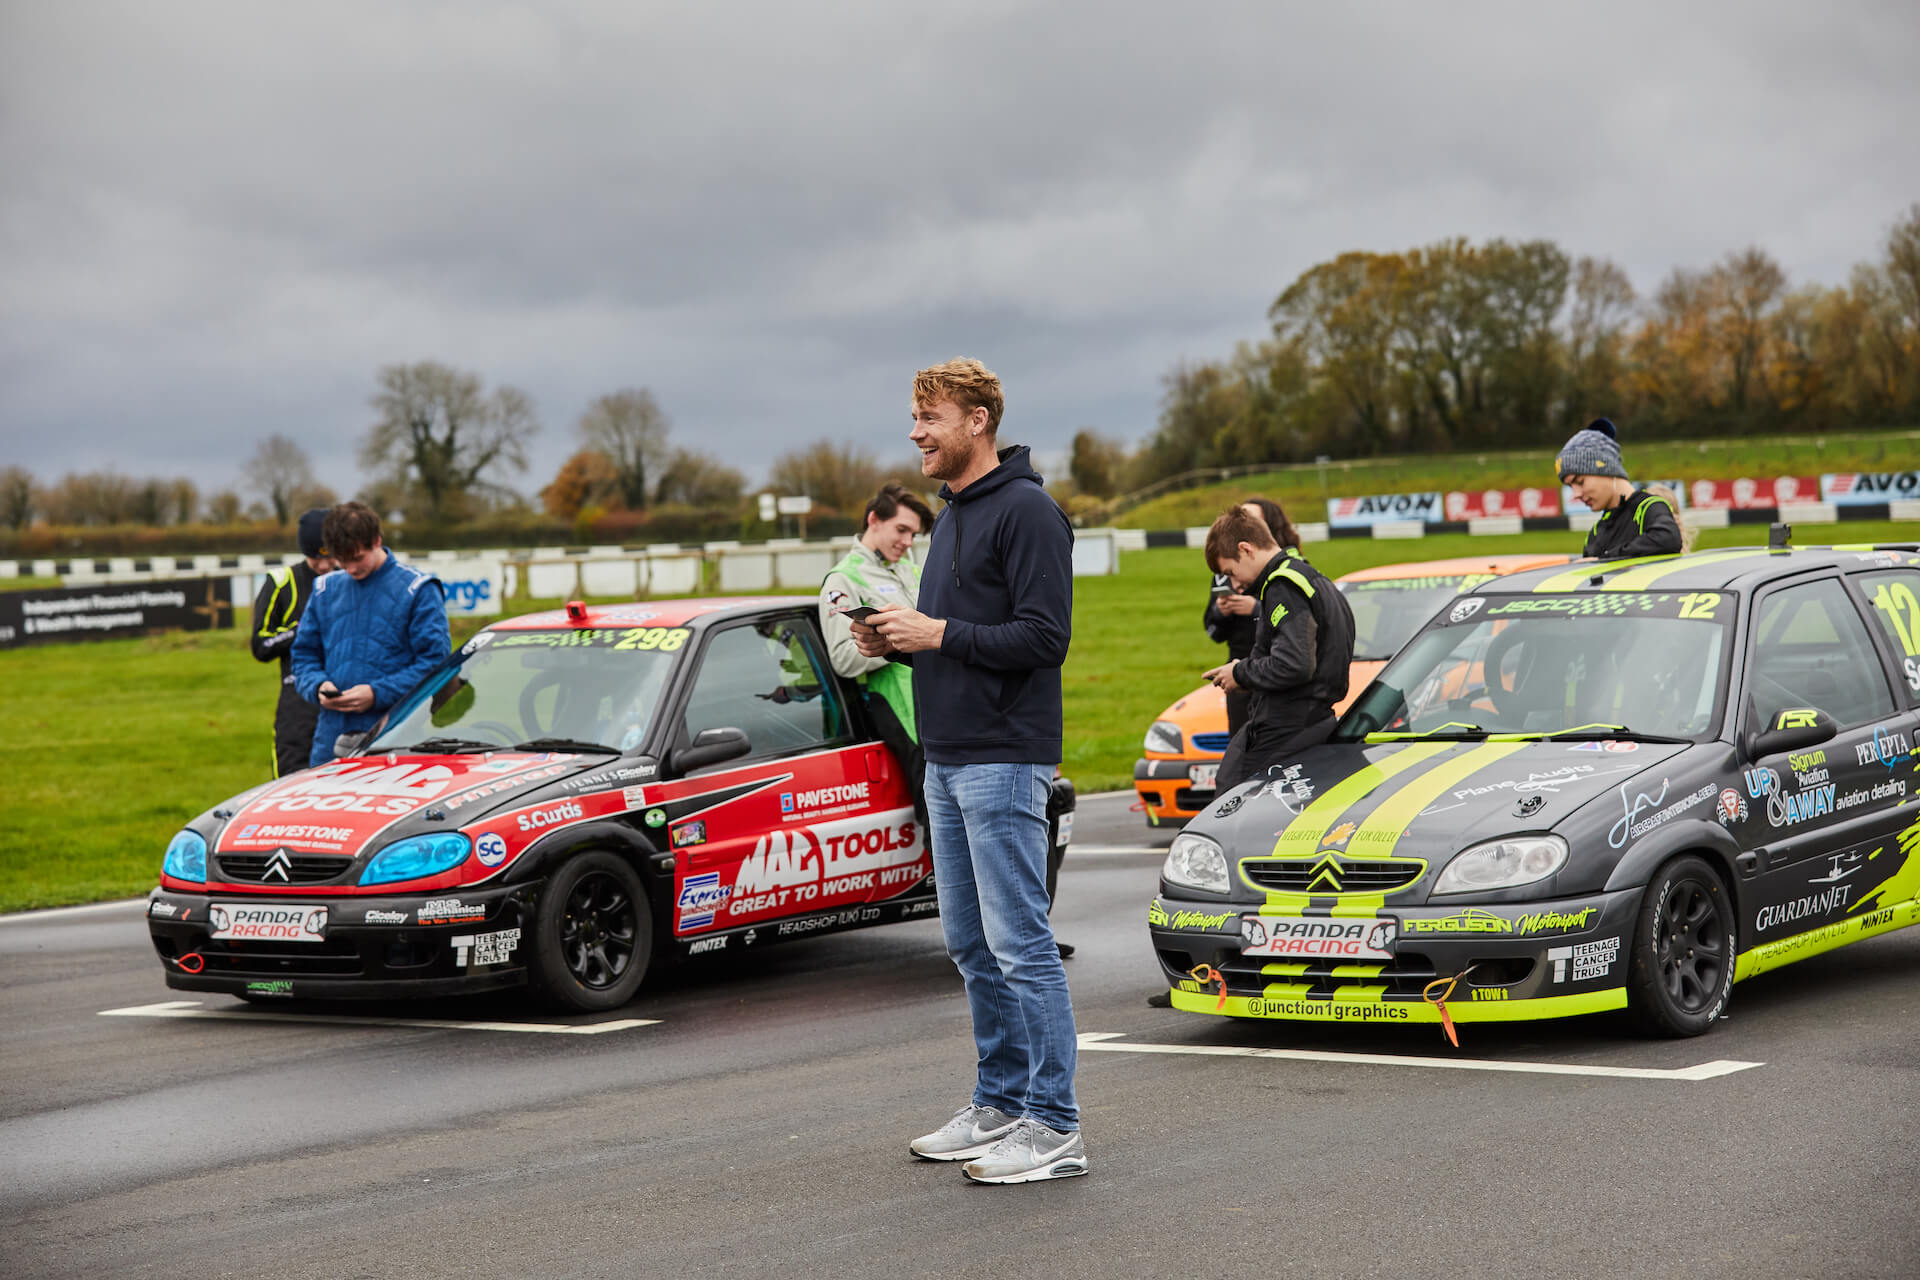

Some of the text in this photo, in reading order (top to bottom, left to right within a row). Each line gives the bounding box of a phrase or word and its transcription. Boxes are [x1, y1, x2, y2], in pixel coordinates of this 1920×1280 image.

[1358, 493, 1436, 515] AVON
[1487, 599, 1579, 614] JSCC
[1677, 592, 1721, 619] 12
[614, 627, 692, 651] 298
[1855, 725, 1910, 768] PERCEPTA
[1789, 750, 1826, 772] Signum
[1453, 763, 1596, 800] Plane Audits
[1744, 767, 1772, 799] UP
[1798, 768, 1829, 787] Aviation
[251, 794, 420, 816] TOOLS
[796, 782, 870, 808] PAVESTONE
[1767, 769, 1789, 828] &
[1787, 783, 1836, 826] AWAY
[1836, 789, 1870, 811] aviation
[1871, 779, 1906, 801] detailing
[517, 802, 583, 831] S.Curtis
[257, 825, 354, 841] PAVESTONE
[826, 823, 917, 862] TOOLS
[479, 841, 502, 857] SC
[729, 890, 792, 917] GREAT
[795, 884, 819, 903] TO
[822, 872, 875, 897] WORK
[880, 864, 924, 886] WITH
[234, 910, 303, 924] PANDA
[417, 904, 485, 916] Mechanical
[1756, 884, 1852, 932] GUARDIANJET
[778, 907, 881, 936] HEADSHOP (UK) LTD
[1171, 910, 1237, 932] Motorsport
[1272, 923, 1365, 938] PANDA
[1403, 906, 1598, 936] FERGUSON Motorsport
[1860, 909, 1895, 931] MINTEX
[231, 925, 300, 938] RACING
[477, 929, 521, 944] TEENAGE
[476, 941, 516, 954] CANCER
[689, 936, 729, 955] MINTEX
[1270, 939, 1361, 954] RACING
[1574, 937, 1620, 956] TEENAGE
[476, 952, 508, 964] TRUST
[1574, 951, 1615, 968] CANCER
[1574, 965, 1608, 980] TRUST
[1478, 988, 1501, 1000] TOW
[1248, 998, 1408, 1020] @junction1graphics
